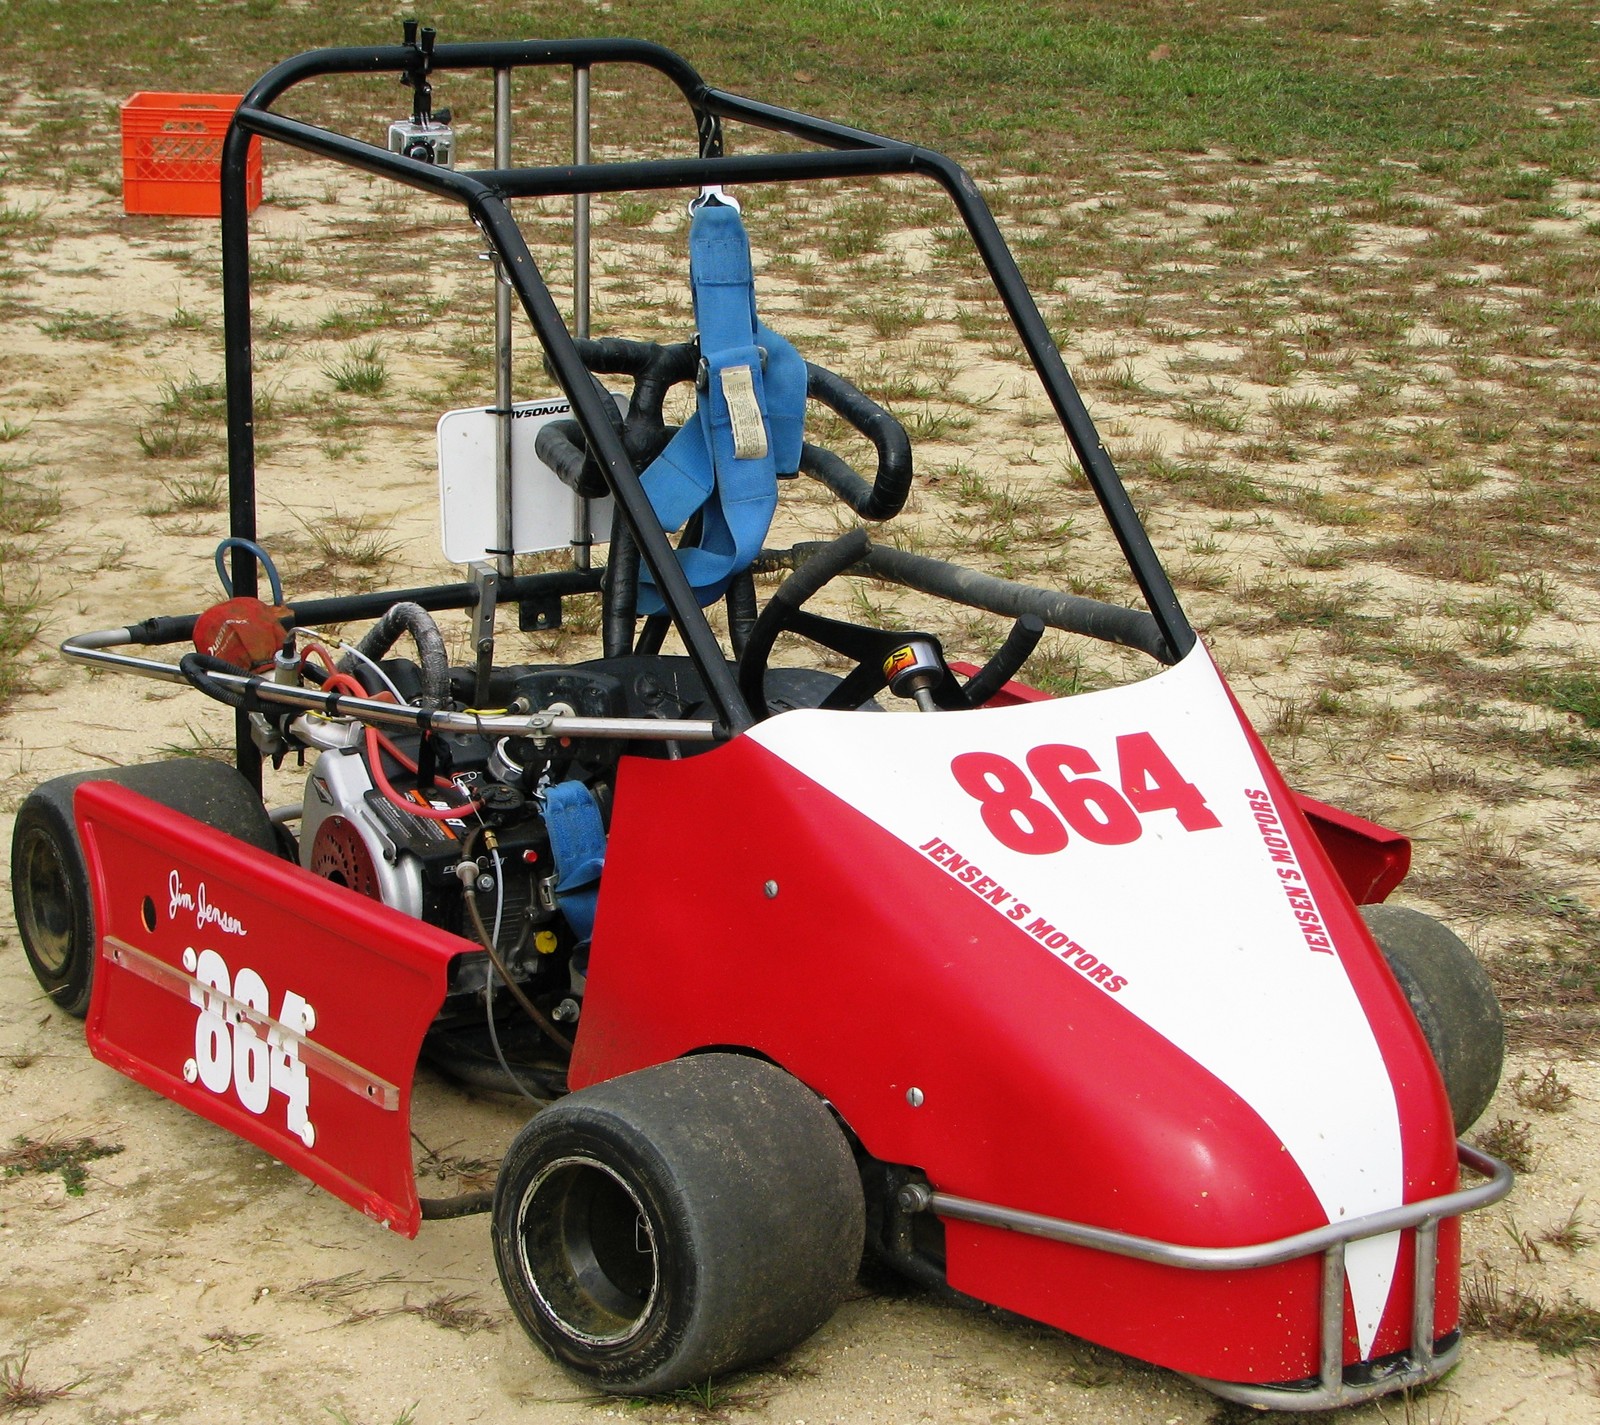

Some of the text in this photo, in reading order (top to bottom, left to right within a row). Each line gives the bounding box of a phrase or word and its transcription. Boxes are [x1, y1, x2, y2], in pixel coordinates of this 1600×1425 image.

[950, 731, 1222, 856] 864
[1244, 788, 1335, 956] JENSEN'S MOTORS
[169, 869, 248, 936] Jim Jensen
[919, 836, 1129, 993] JENSEN'S MOTORS
[189, 948, 310, 1142] 864
